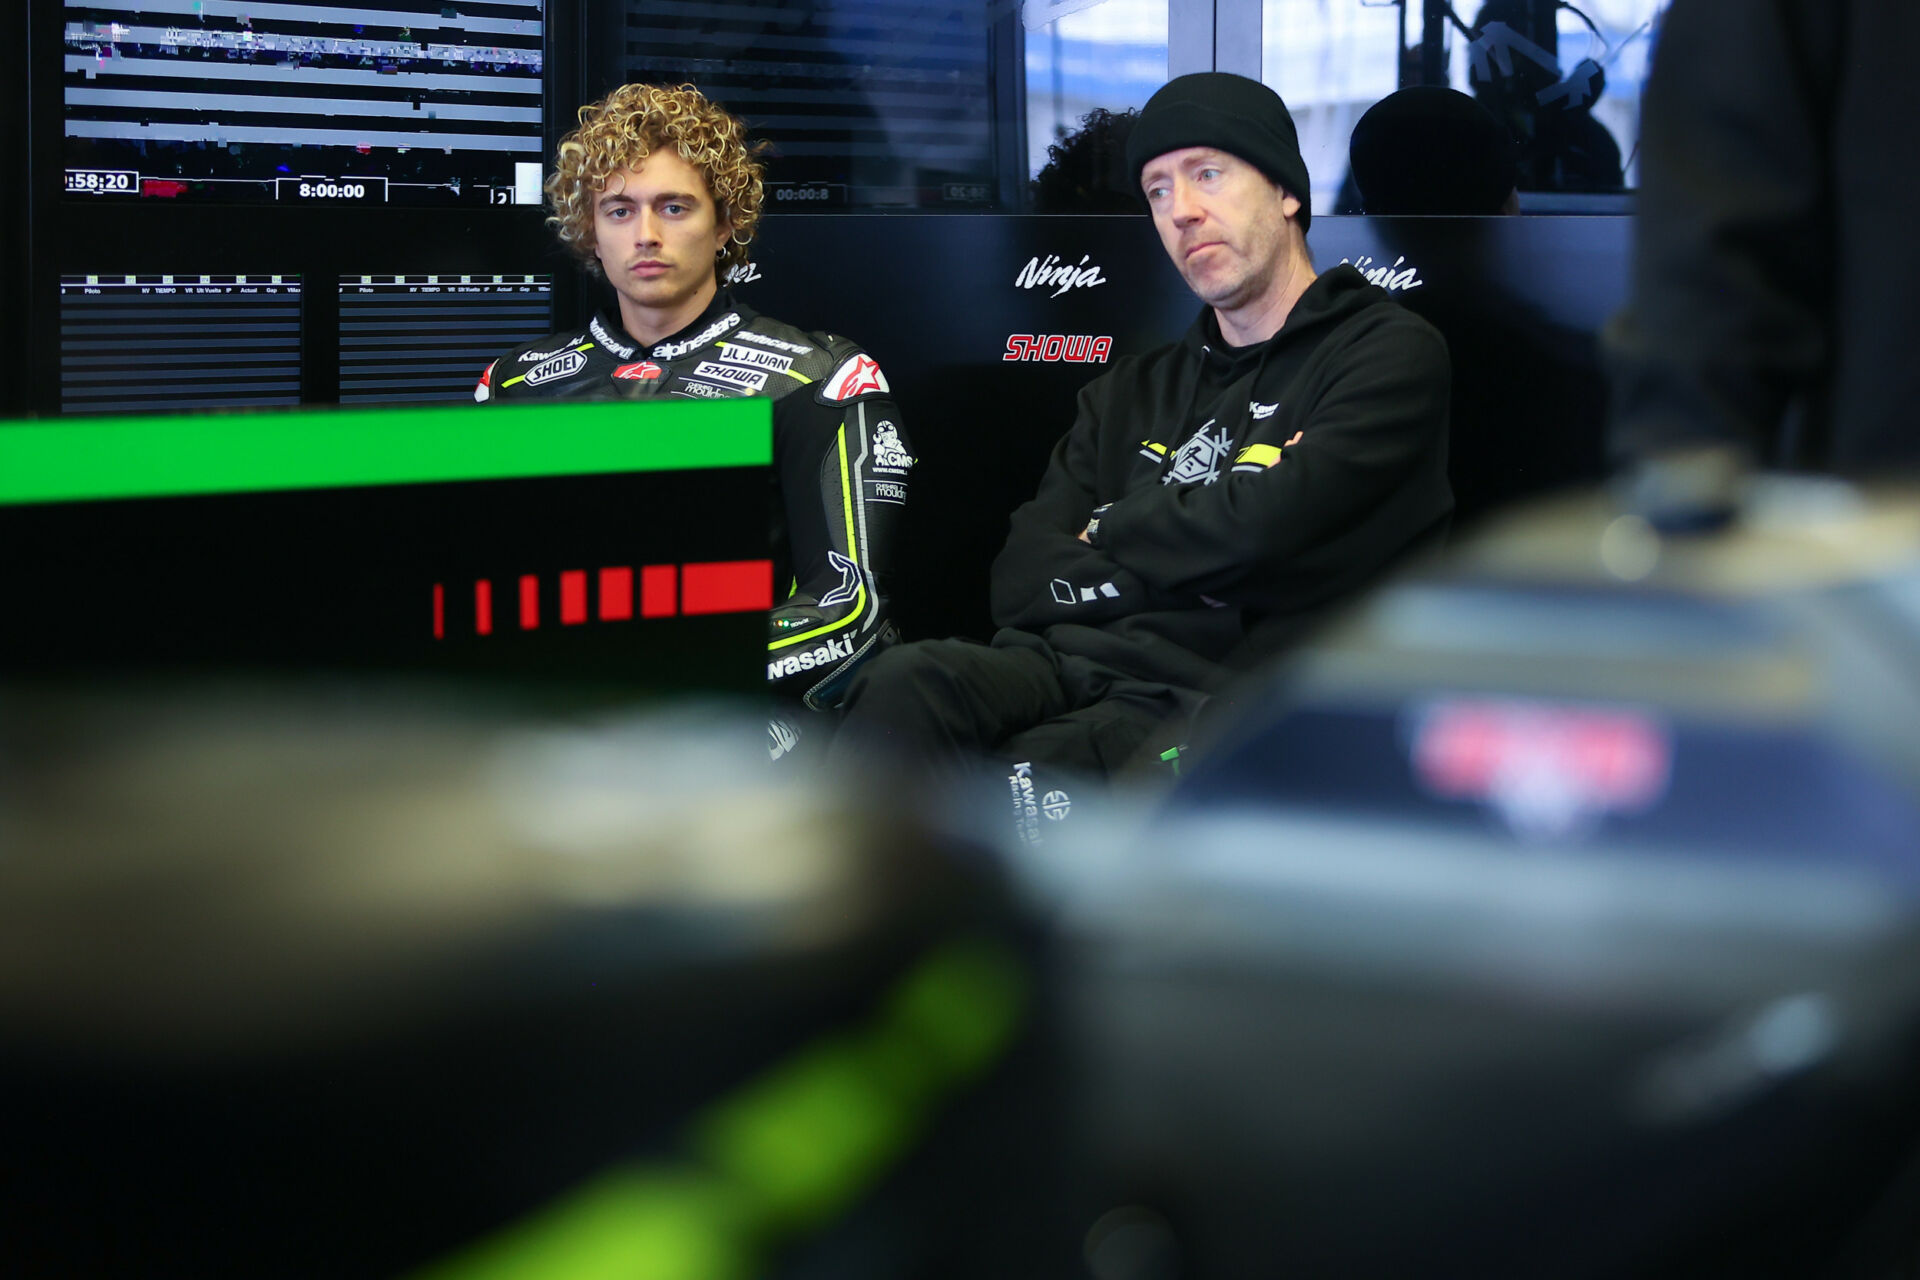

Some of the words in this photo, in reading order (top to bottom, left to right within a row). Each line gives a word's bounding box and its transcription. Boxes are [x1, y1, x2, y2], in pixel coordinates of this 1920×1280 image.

[65, 173, 129, 190] :58:20
[299, 183, 365, 198] 8:00:00
[1015, 254, 1107, 299] Ninja
[1338, 255, 1423, 291] inja
[652, 312, 741, 360] alpinestars
[1003, 334, 1113, 363] SHOWA
[533, 355, 577, 380] SHOEI
[700, 365, 763, 386] SHOWA
[888, 453, 913, 468] CMS
